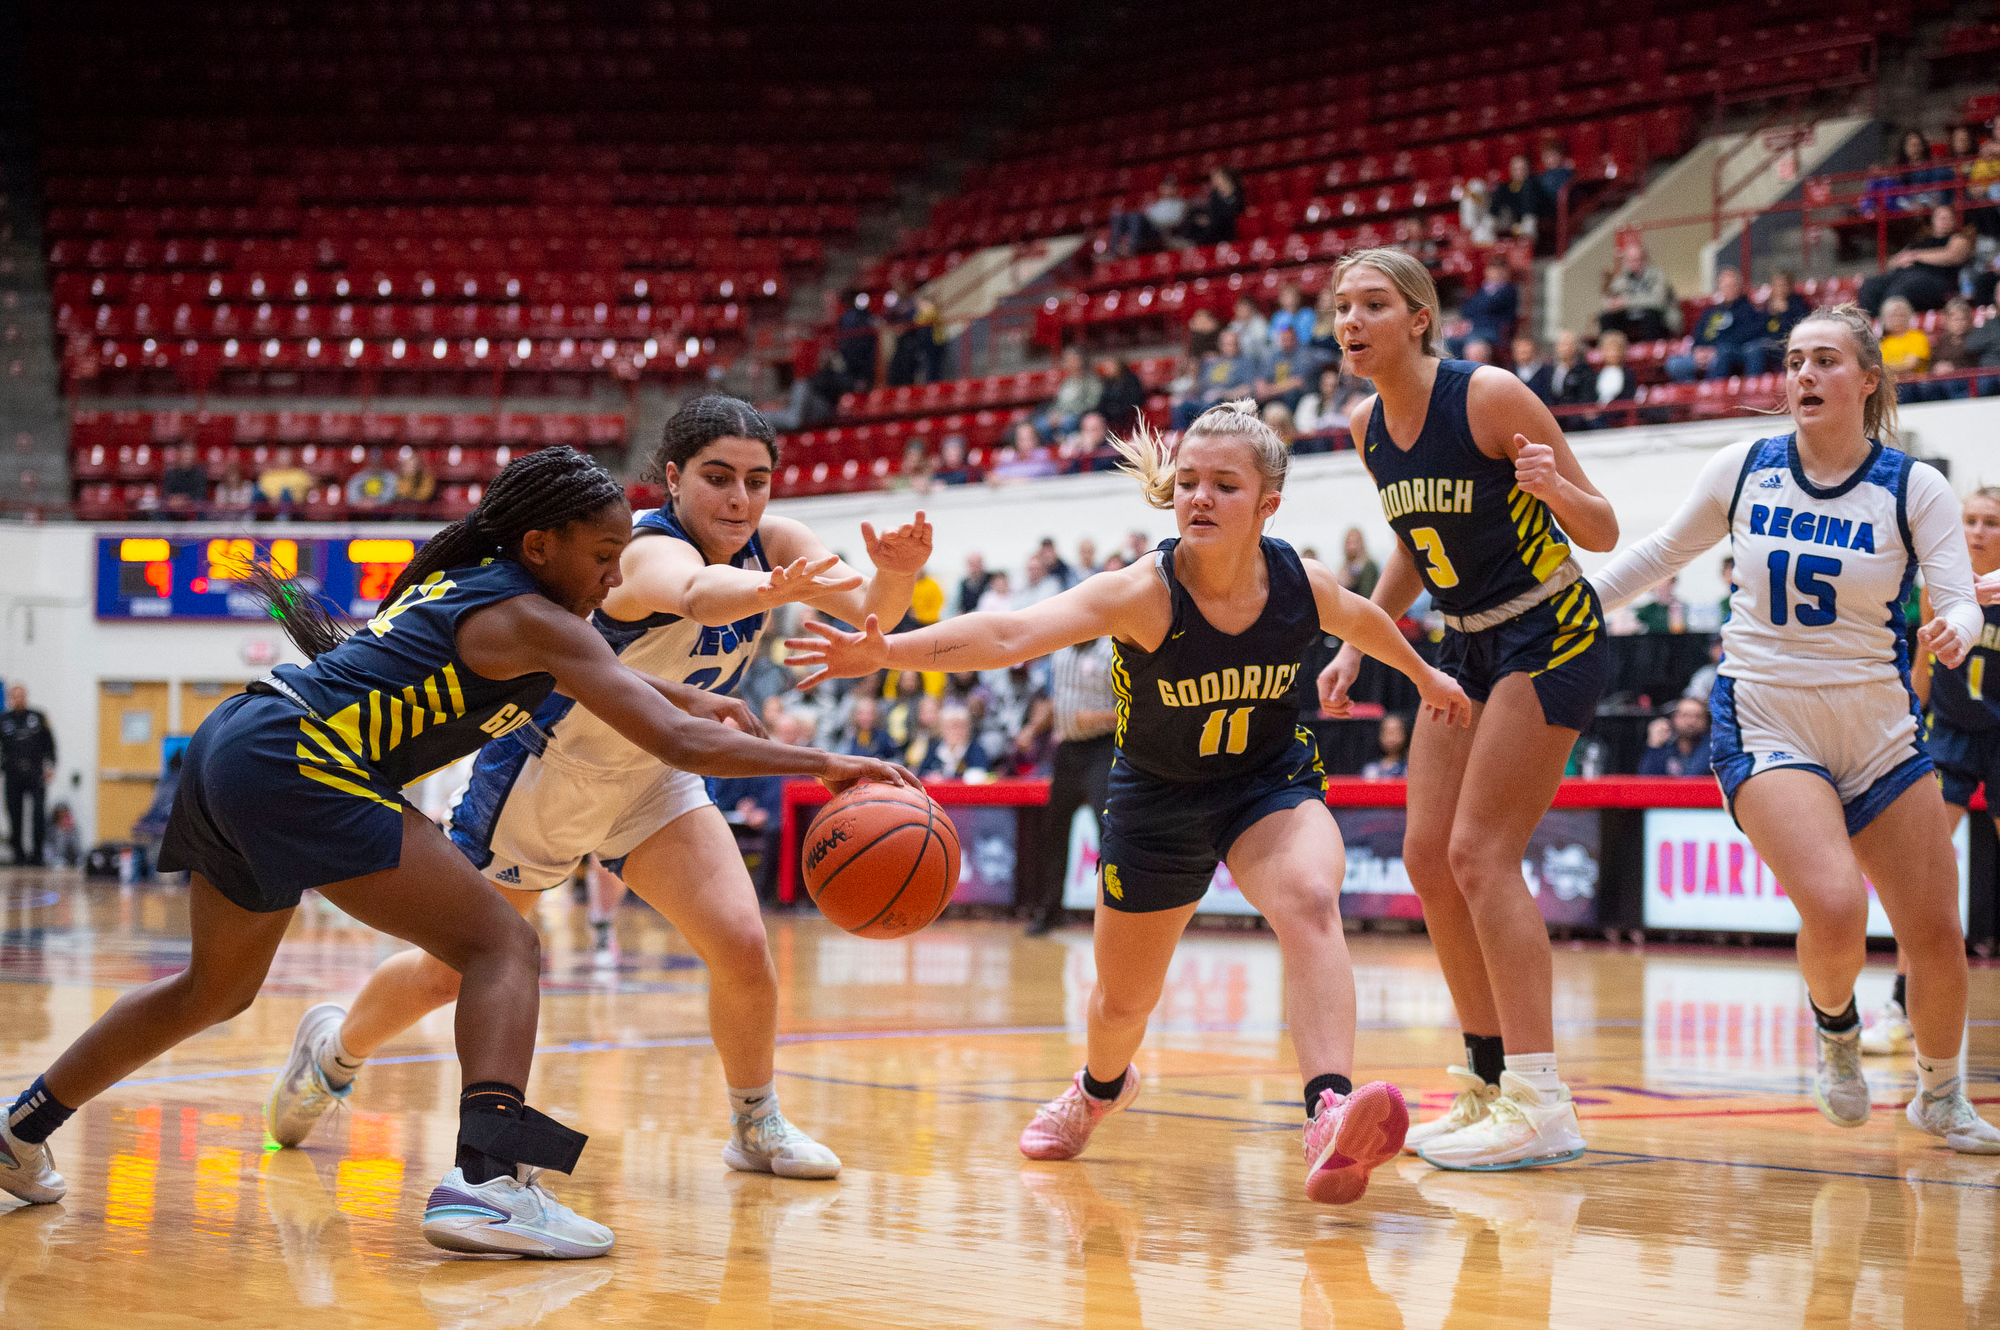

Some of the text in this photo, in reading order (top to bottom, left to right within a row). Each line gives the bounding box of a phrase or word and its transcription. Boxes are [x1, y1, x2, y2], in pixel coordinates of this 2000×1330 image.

[1380, 478, 1473, 522] OODRICH
[1750, 504, 1875, 554] REGINA
[1410, 527, 1459, 588] 3
[1768, 550, 1842, 626] 15
[1199, 706, 1255, 757] 11
[496, 873, 521, 884] adidas
